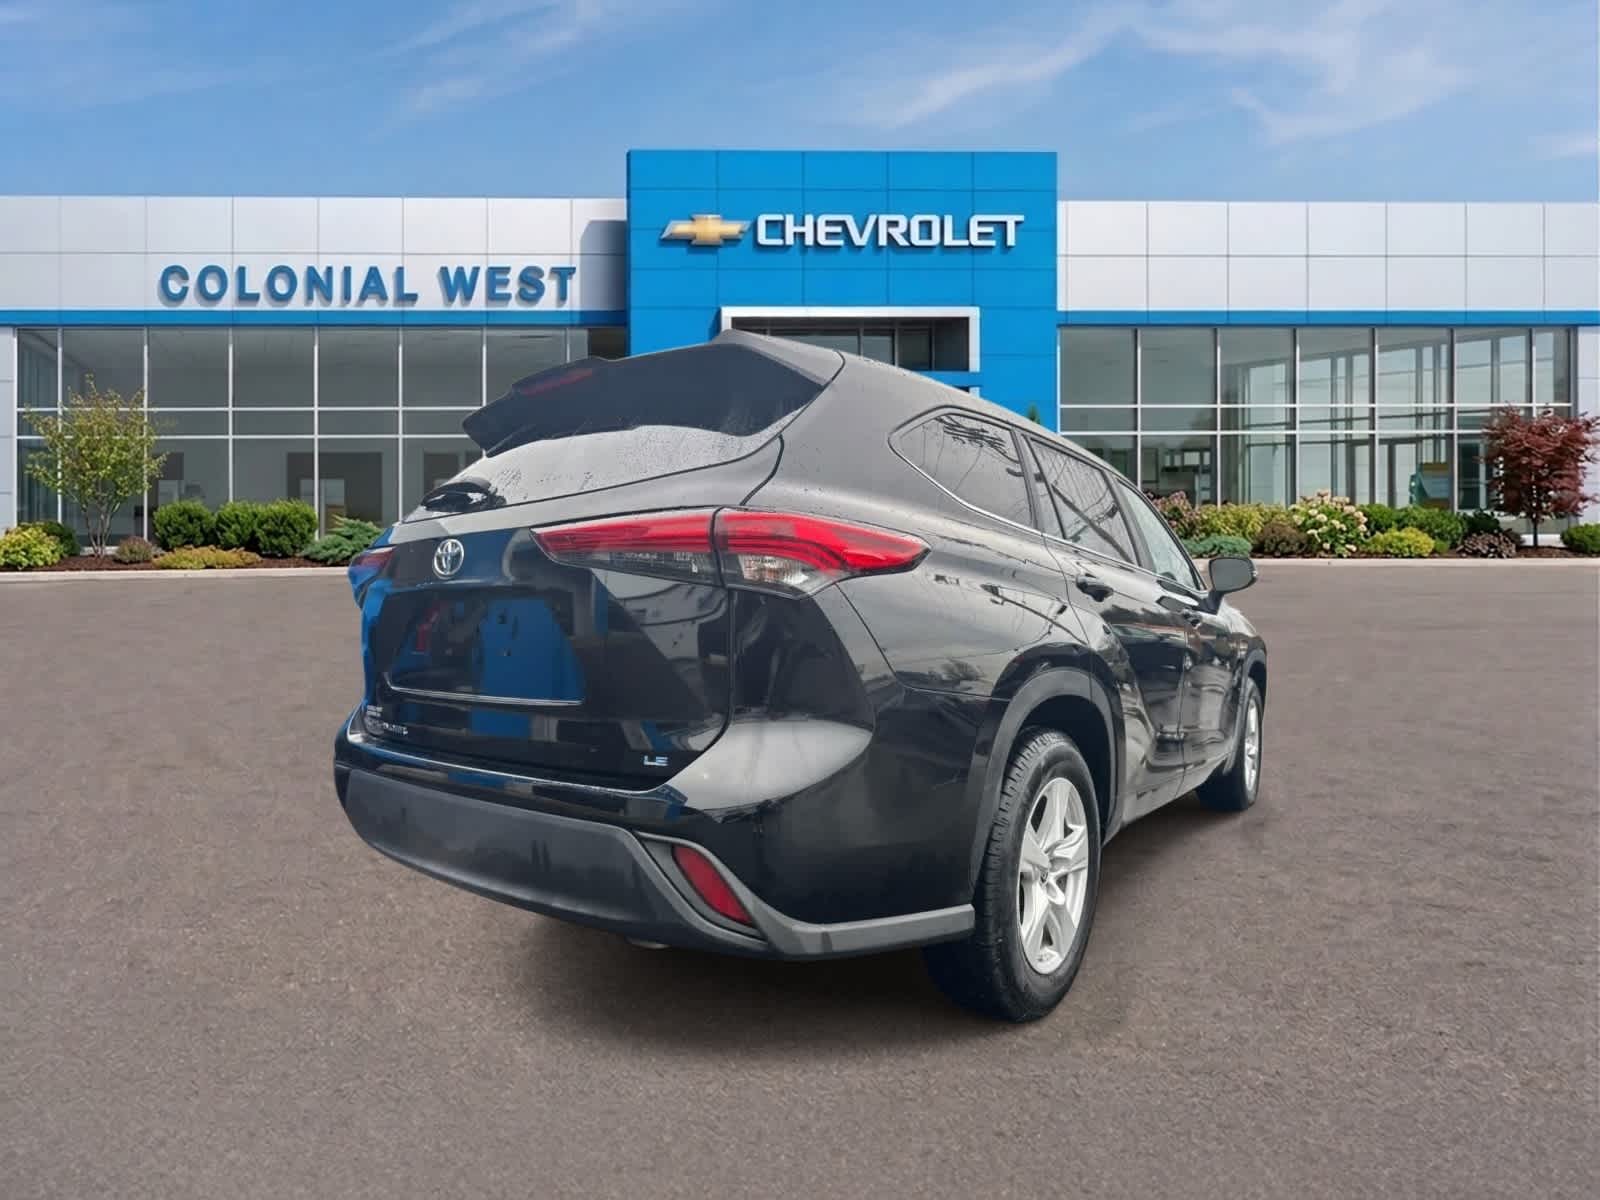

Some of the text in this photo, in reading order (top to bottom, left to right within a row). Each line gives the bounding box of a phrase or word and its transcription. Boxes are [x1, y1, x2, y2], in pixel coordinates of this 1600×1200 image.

[757, 214, 1024, 248] CHEVROLET
[160, 265, 577, 305] COLONIAL WEST
[643, 755, 669, 767] LE
